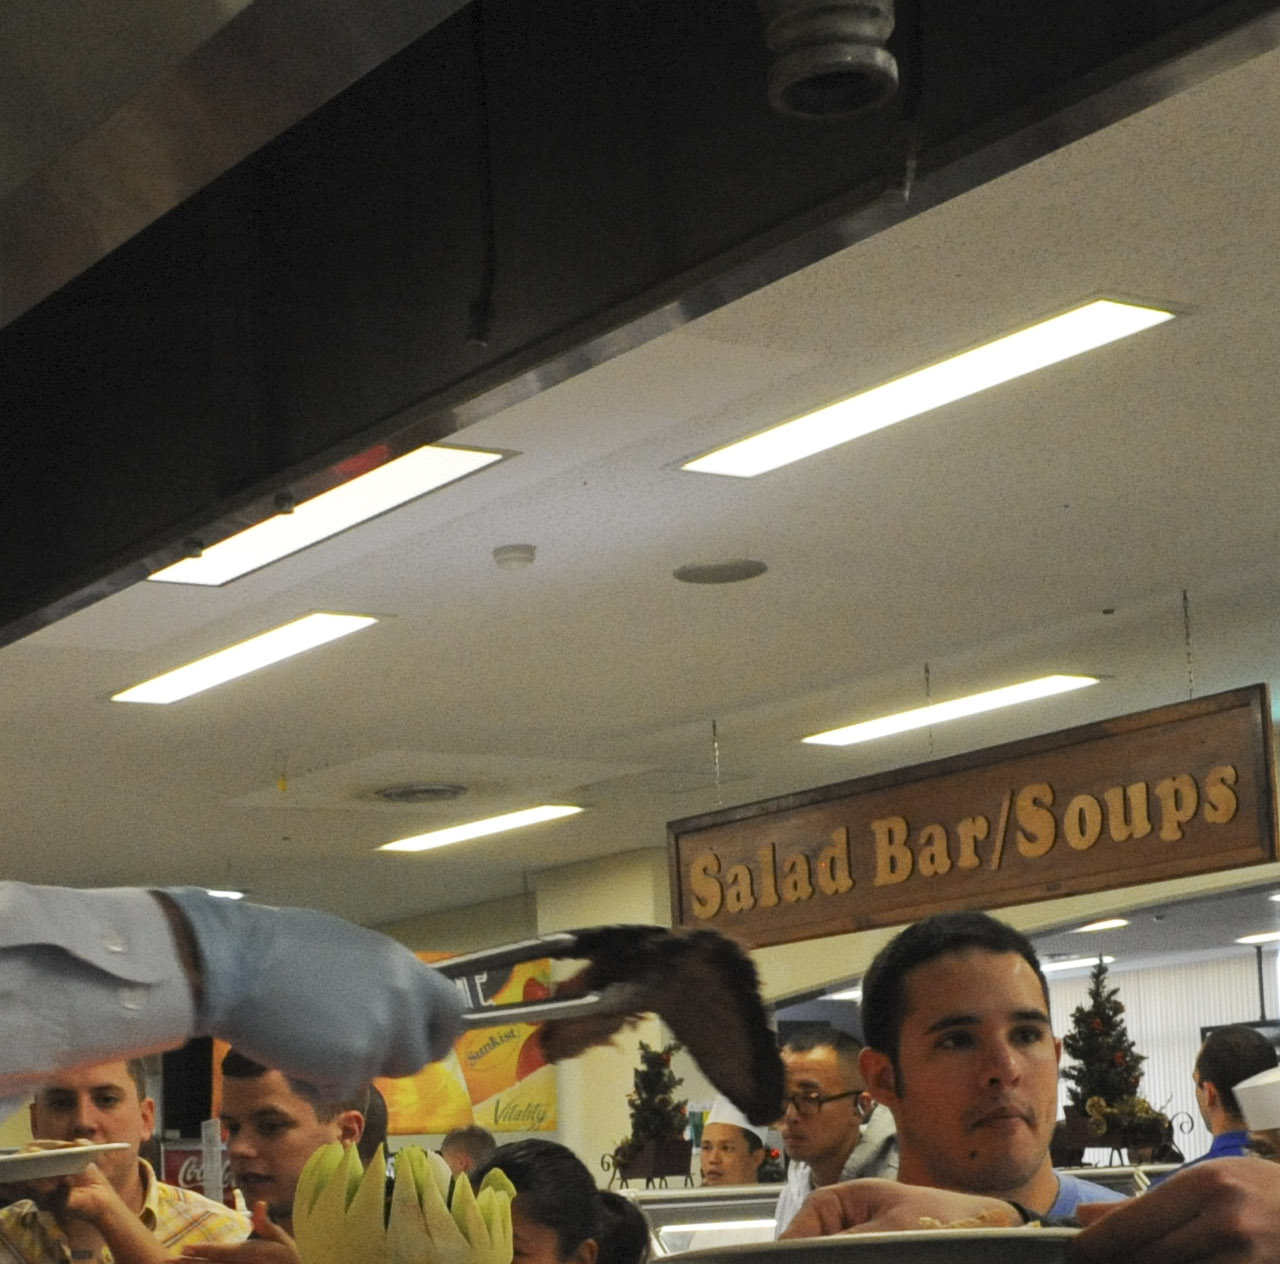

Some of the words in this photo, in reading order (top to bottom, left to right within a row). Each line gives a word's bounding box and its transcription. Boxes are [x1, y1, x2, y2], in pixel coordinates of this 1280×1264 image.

[689, 824, 854, 920] Salad
[871, 763, 1240, 888] Bar/Soups
[466, 1028, 517, 1066] Sunkist
[493, 1098, 548, 1131] Vitality
